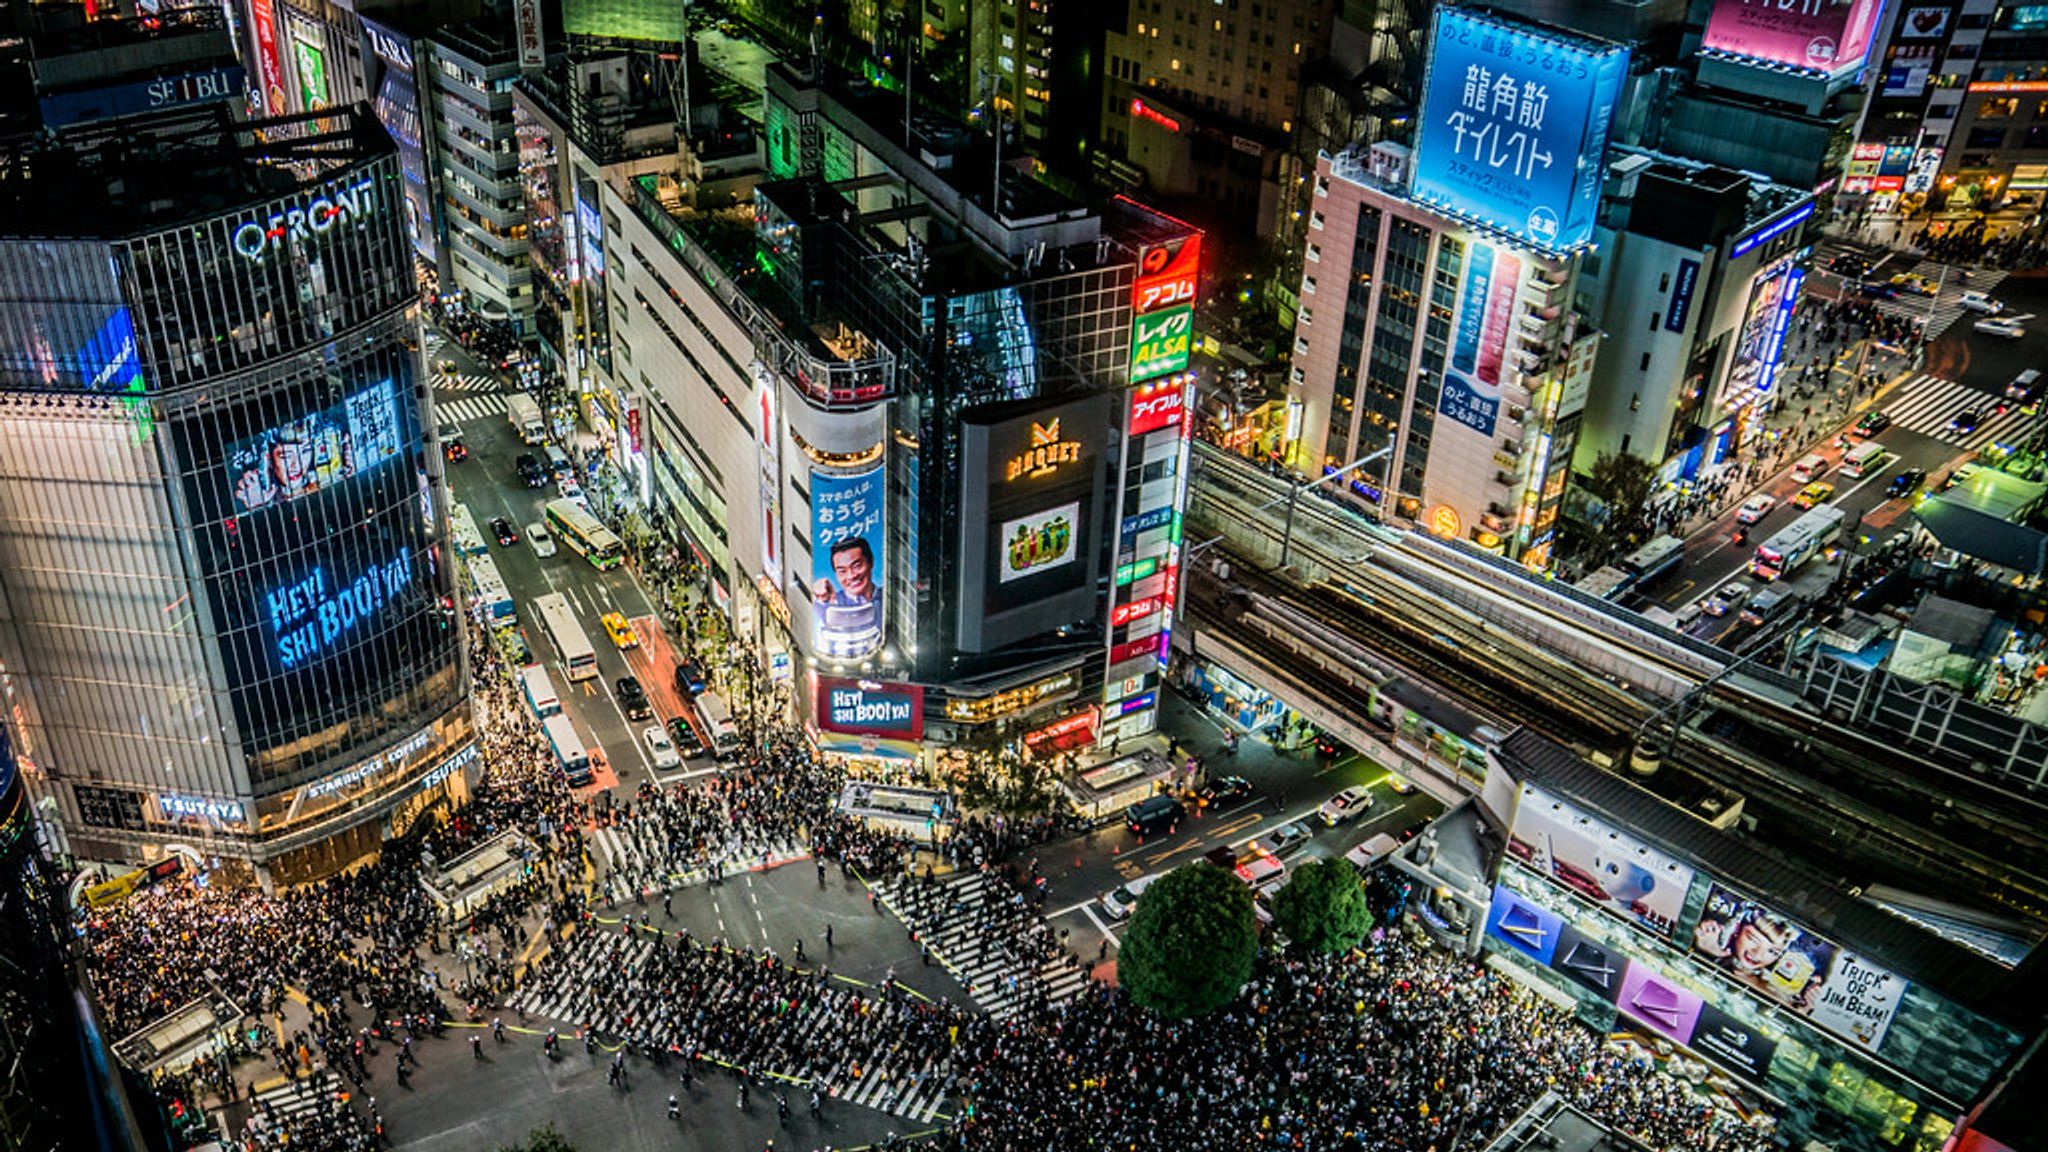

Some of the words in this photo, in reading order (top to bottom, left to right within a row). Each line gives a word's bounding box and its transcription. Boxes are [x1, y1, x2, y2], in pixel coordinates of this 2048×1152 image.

[366, 27, 413, 72] ZARA
[148, 72, 231, 106] SEIBU
[1462, 63, 1550, 131] 龍角散
[1446, 110, 1554, 181] ダイレクト
[1142, 280, 1193, 308] アコム
[1138, 311, 1189, 344] レイク
[1135, 334, 1188, 364] ALSA
[1133, 393, 1182, 419] アイフル
[819, 498, 866, 523] おうち
[267, 566, 326, 633] HEY!
[279, 621, 318, 668] SHI
[833, 690, 863, 707] HEY!
[834, 708, 855, 722] SHI
[856, 702, 891, 721] BOO!
[892, 703, 910, 719] YA!
[308, 756, 384, 798] STARBUCKS
[423, 744, 478, 789] TSUTAYA
[161, 797, 243, 820] TSUTAYA
[1841, 956, 1883, 990] TRICK
[1846, 980, 1868, 997] OR
[1821, 987, 1846, 1009] JIM
[1846, 996, 1890, 1023] BEAM!
